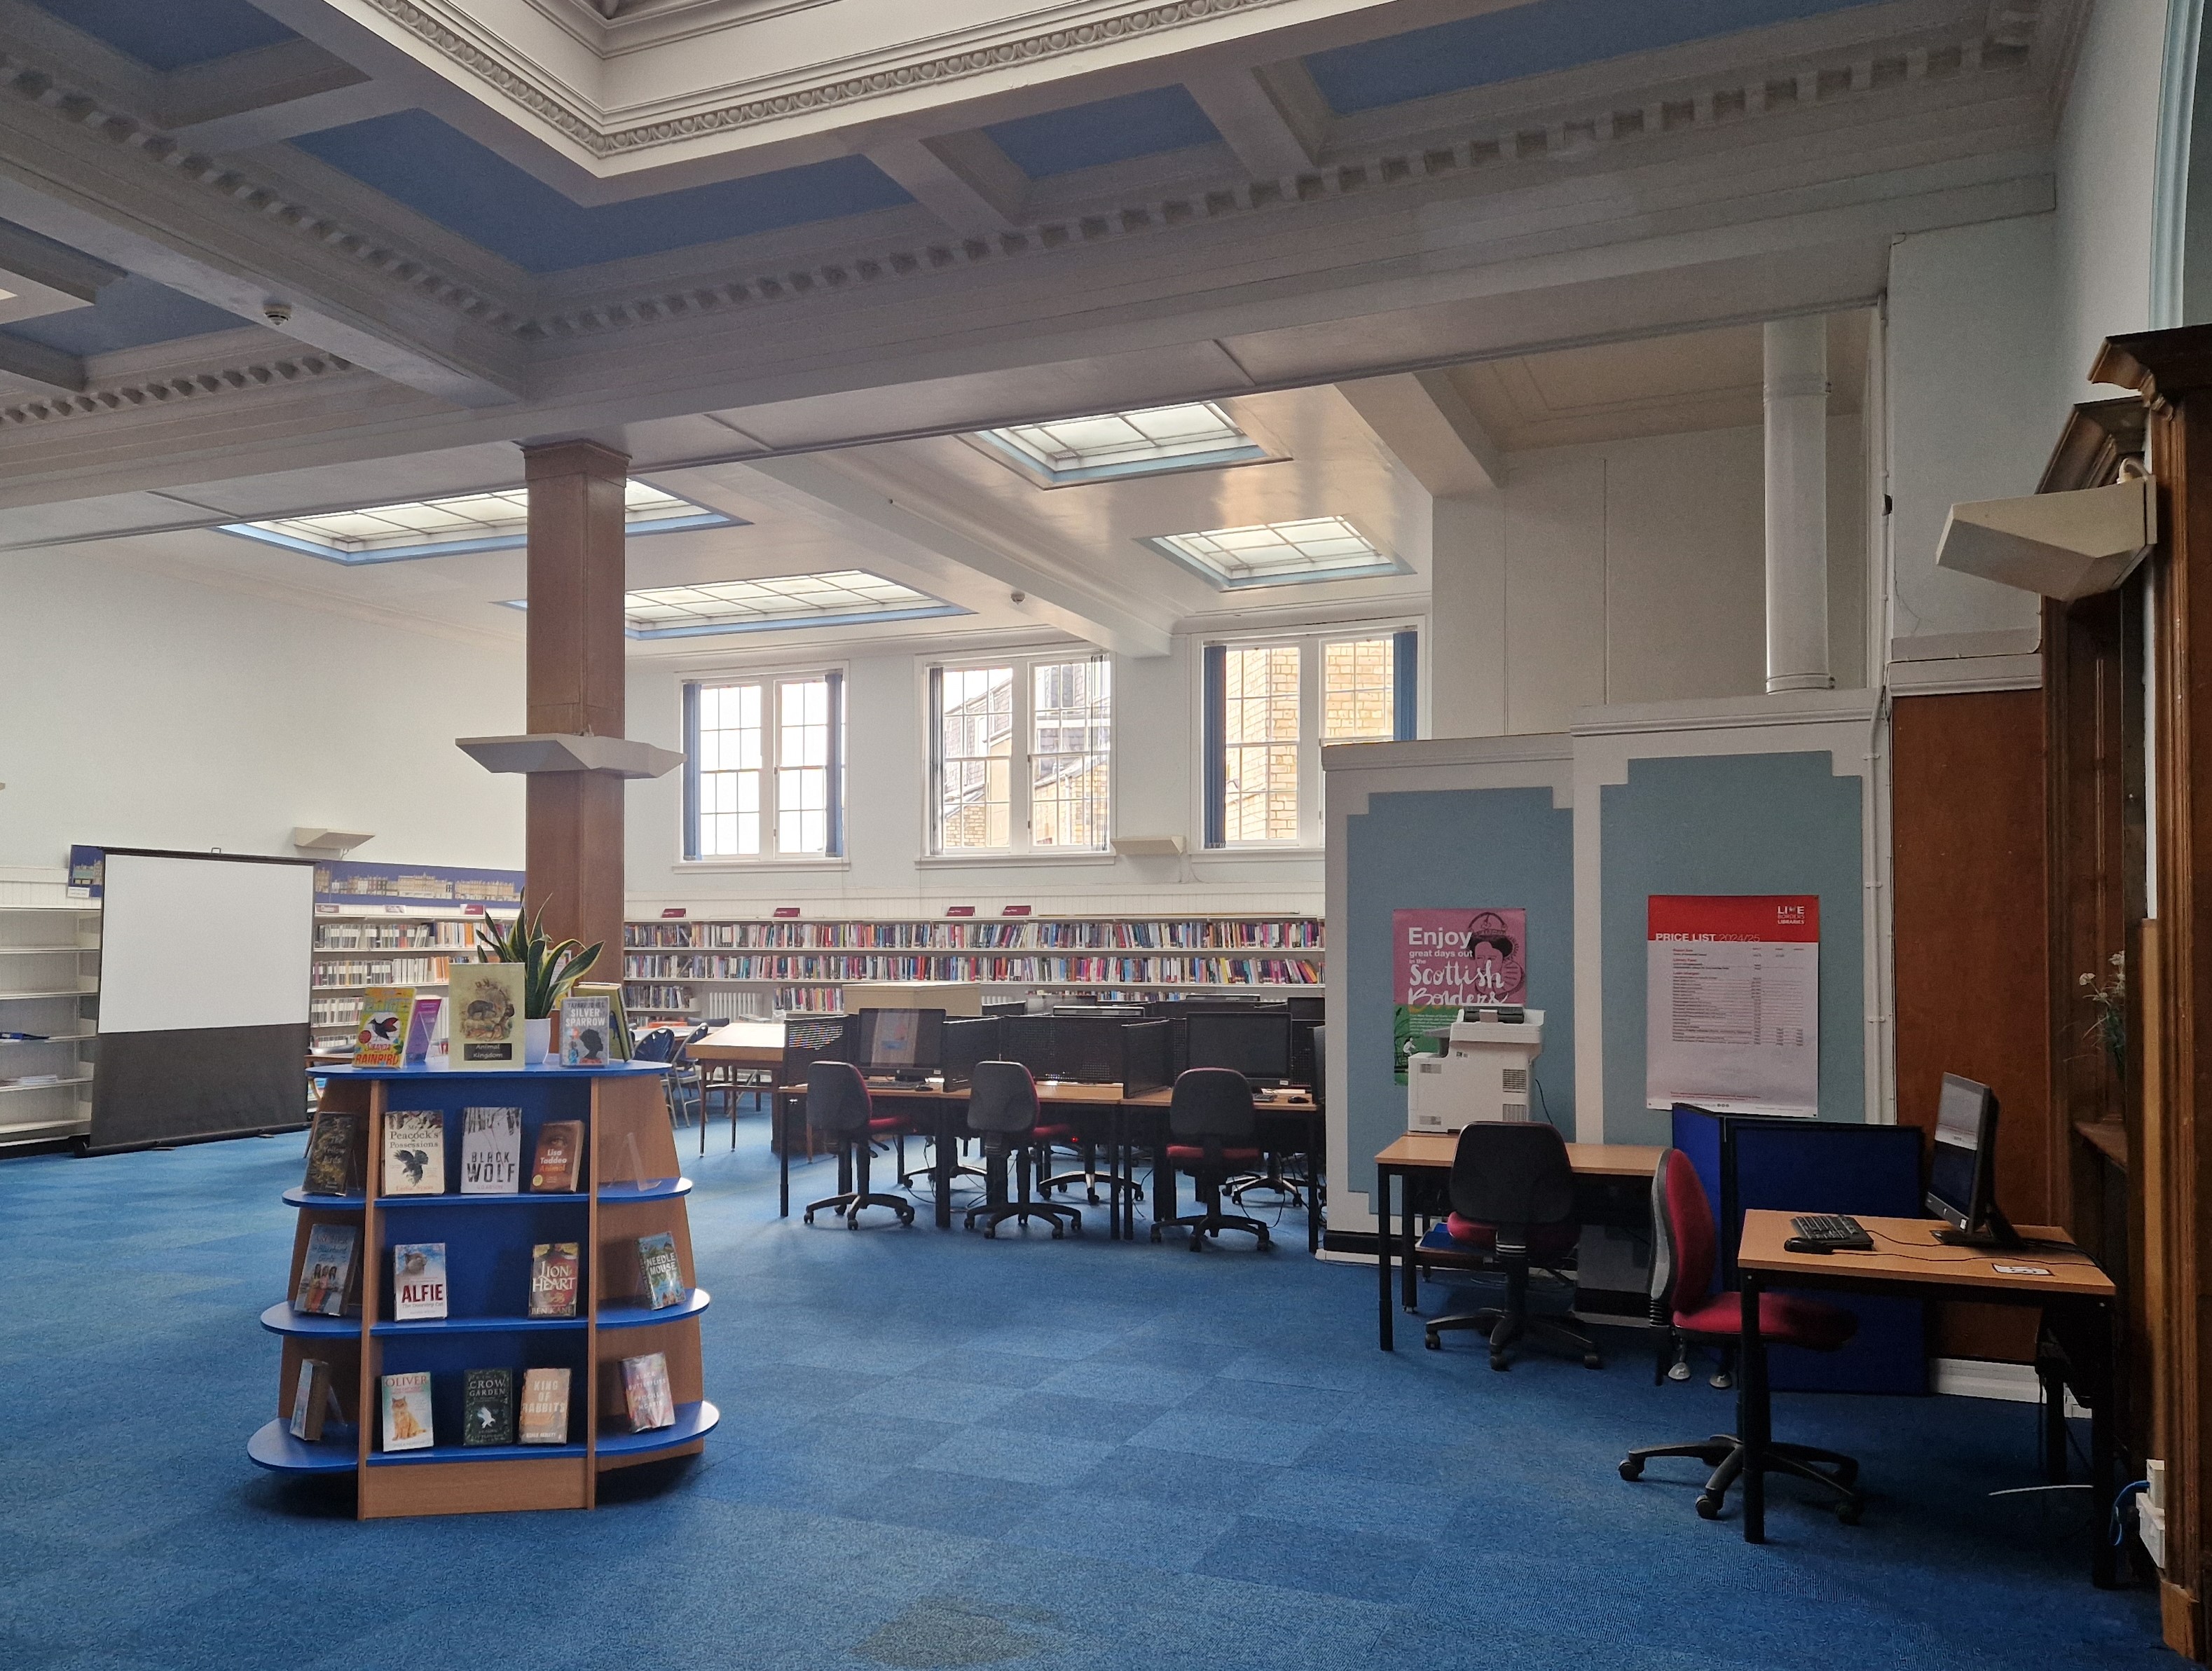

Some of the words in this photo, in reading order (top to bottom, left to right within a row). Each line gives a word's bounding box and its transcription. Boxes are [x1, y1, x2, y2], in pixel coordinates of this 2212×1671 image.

[1408, 927, 1473, 949] Enjoy
[1655, 933, 1689, 942] PRICE
[1692, 933, 1717, 942] LIST
[1719, 934, 1761, 942] 2024/25
[1409, 950, 1433, 958] great
[1434, 949, 1455, 958] days
[1409, 959, 1505, 989] Scottish
[1408, 983, 1509, 1008] Borders
[570, 1008, 600, 1017] SILVER
[565, 1017, 606, 1027] SPARROW
[390, 1130, 439, 1140] Peacock's
[472, 1151, 509, 1163] BLACK
[467, 1163, 515, 1183] WOLF
[646, 1252, 677, 1267] NEEDLE
[538, 1260, 569, 1278] LION
[649, 1261, 678, 1276] MOUSE
[533, 1277, 576, 1293] HEART
[401, 1284, 444, 1303] ALFIE
[385, 1375, 427, 1387] OLIVER
[469, 1379, 505, 1389] CROW
[534, 1380, 559, 1391] KING
[469, 1388, 506, 1397] GARDEN
[538, 1391, 551, 1402] OF
